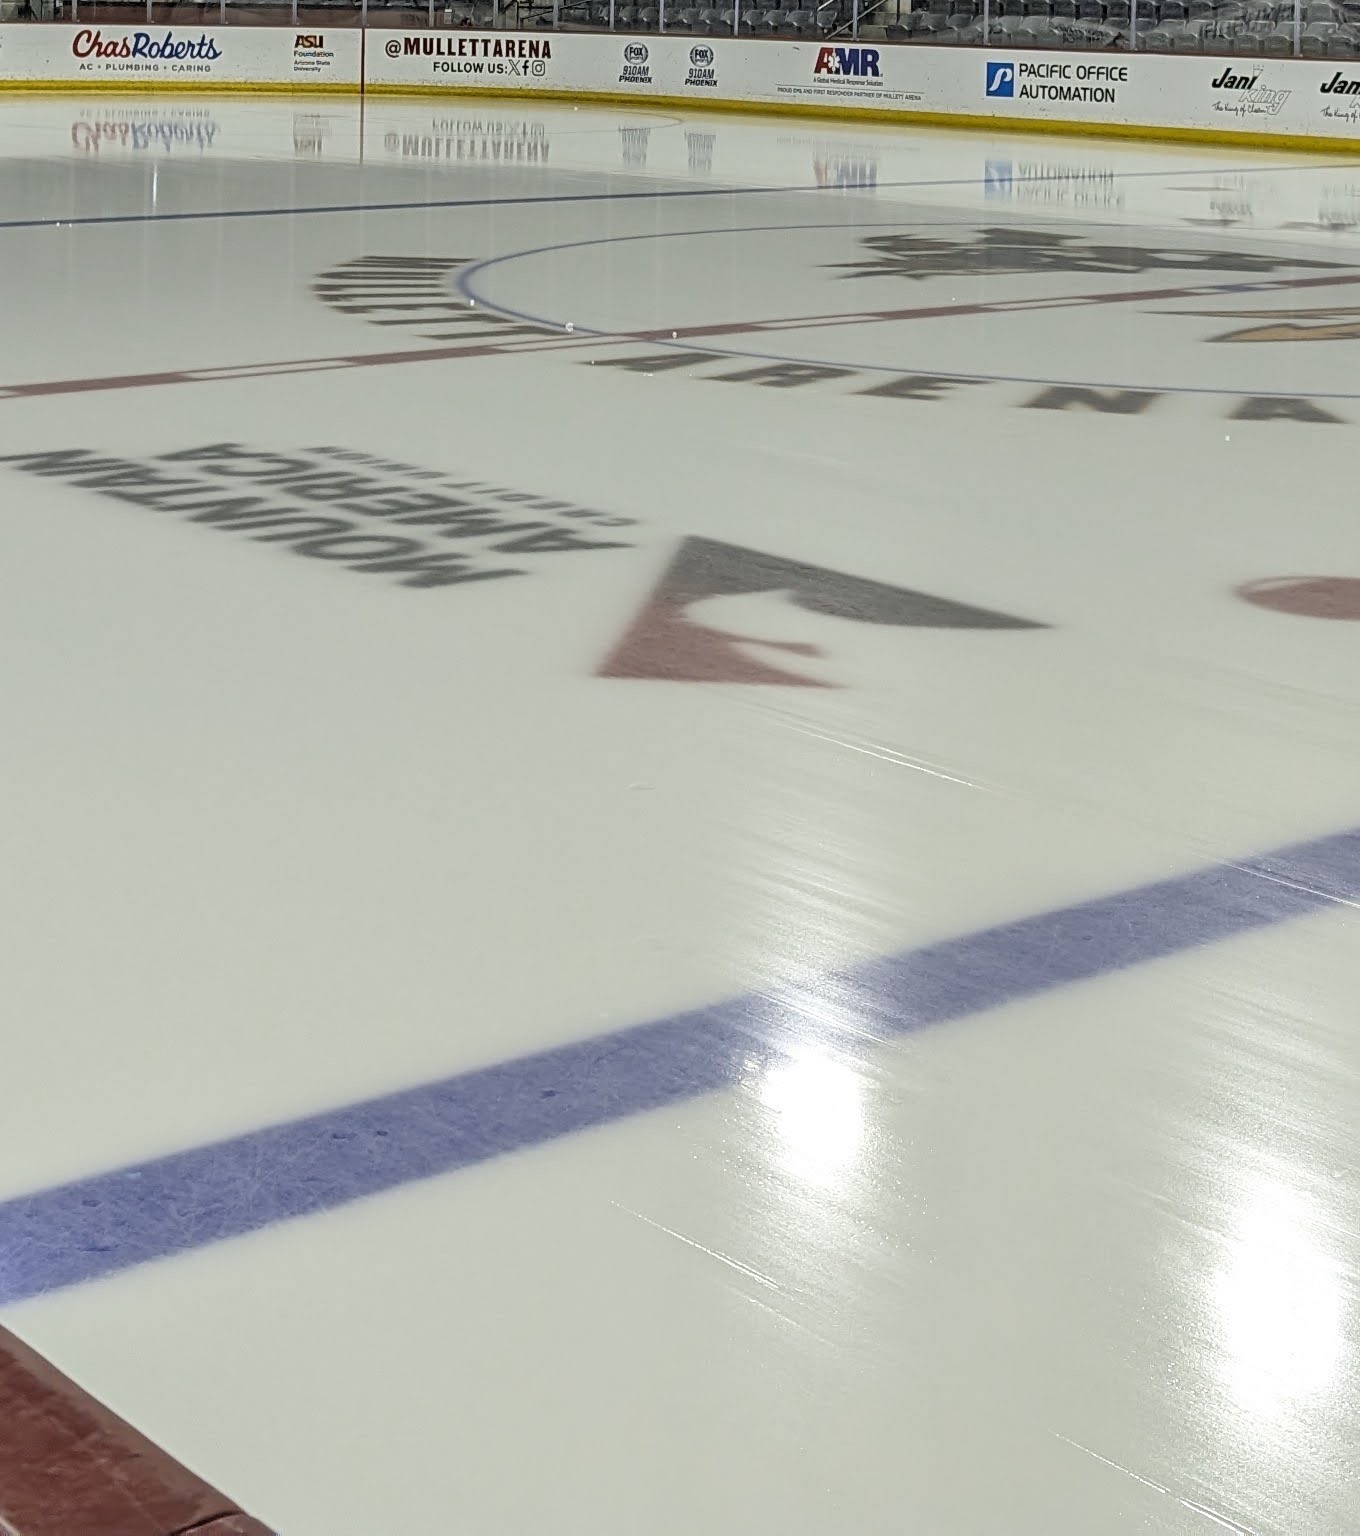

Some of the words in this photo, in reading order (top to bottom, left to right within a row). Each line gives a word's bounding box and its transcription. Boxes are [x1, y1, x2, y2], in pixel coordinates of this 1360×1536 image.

[295, 34, 324, 49] ASU
[385, 37, 551, 59] @MULLETTARENA
[79, 63, 93, 71] AC
[105, 63, 160, 72] PLUMBING
[171, 64, 211, 73] CARING
[433, 61, 485, 74] FOLLOW
[487, 62, 508, 74] US:
[622, 65, 649, 77] 910AM
[813, 47, 880, 77] AMR
[688, 67, 715, 79] 910AM
[1019, 62, 1071, 79] PACIFIC
[1076, 65, 1128, 82] OFFICE
[1019, 84, 1116, 103] AUTOMATION
[1239, 85, 1291, 116] king
[155, 441, 640, 554] AMERICA
